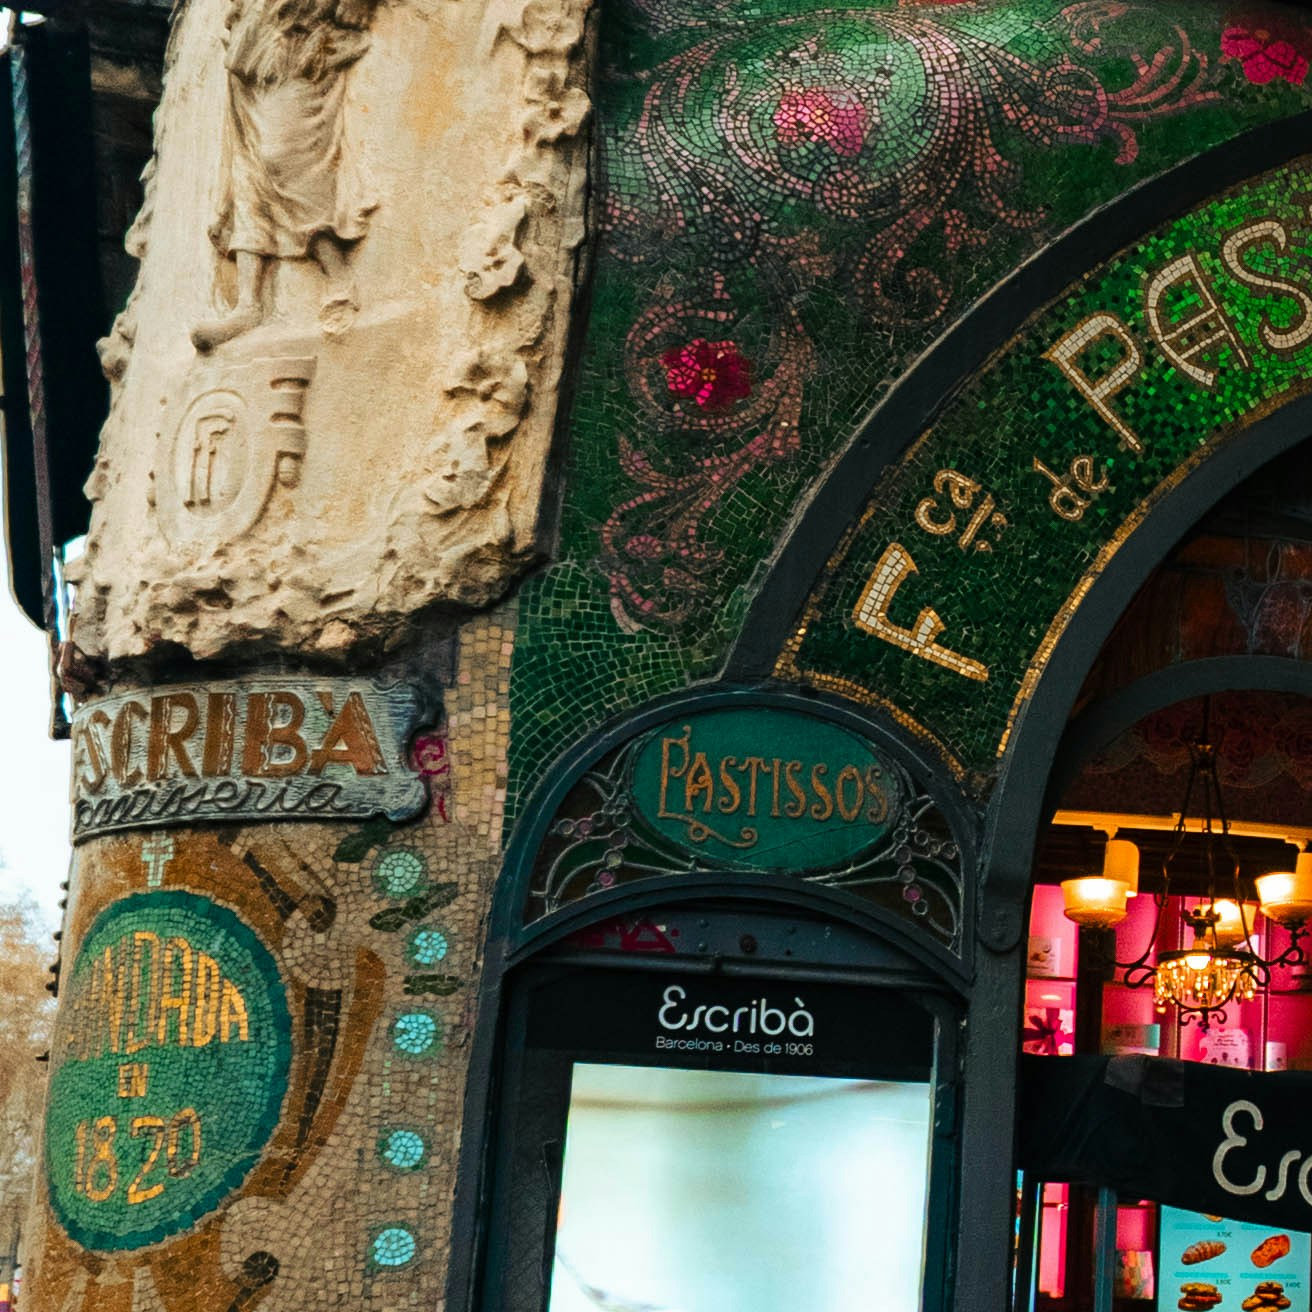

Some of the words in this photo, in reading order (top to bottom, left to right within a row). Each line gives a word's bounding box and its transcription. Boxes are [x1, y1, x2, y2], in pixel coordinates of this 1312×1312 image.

[1032, 455, 1110, 522] de
[656, 725, 890, 848] PASTISSOS
[657, 985, 815, 1037] Escribà
[655, 1036, 723, 1052] Barcelona
[734, 1040, 760, 1054] Des
[763, 1041, 782, 1055] de
[785, 1042, 814, 1056] 1906
[118, 1062, 148, 1098] EN
[74, 1107, 202, 1205] 1820
